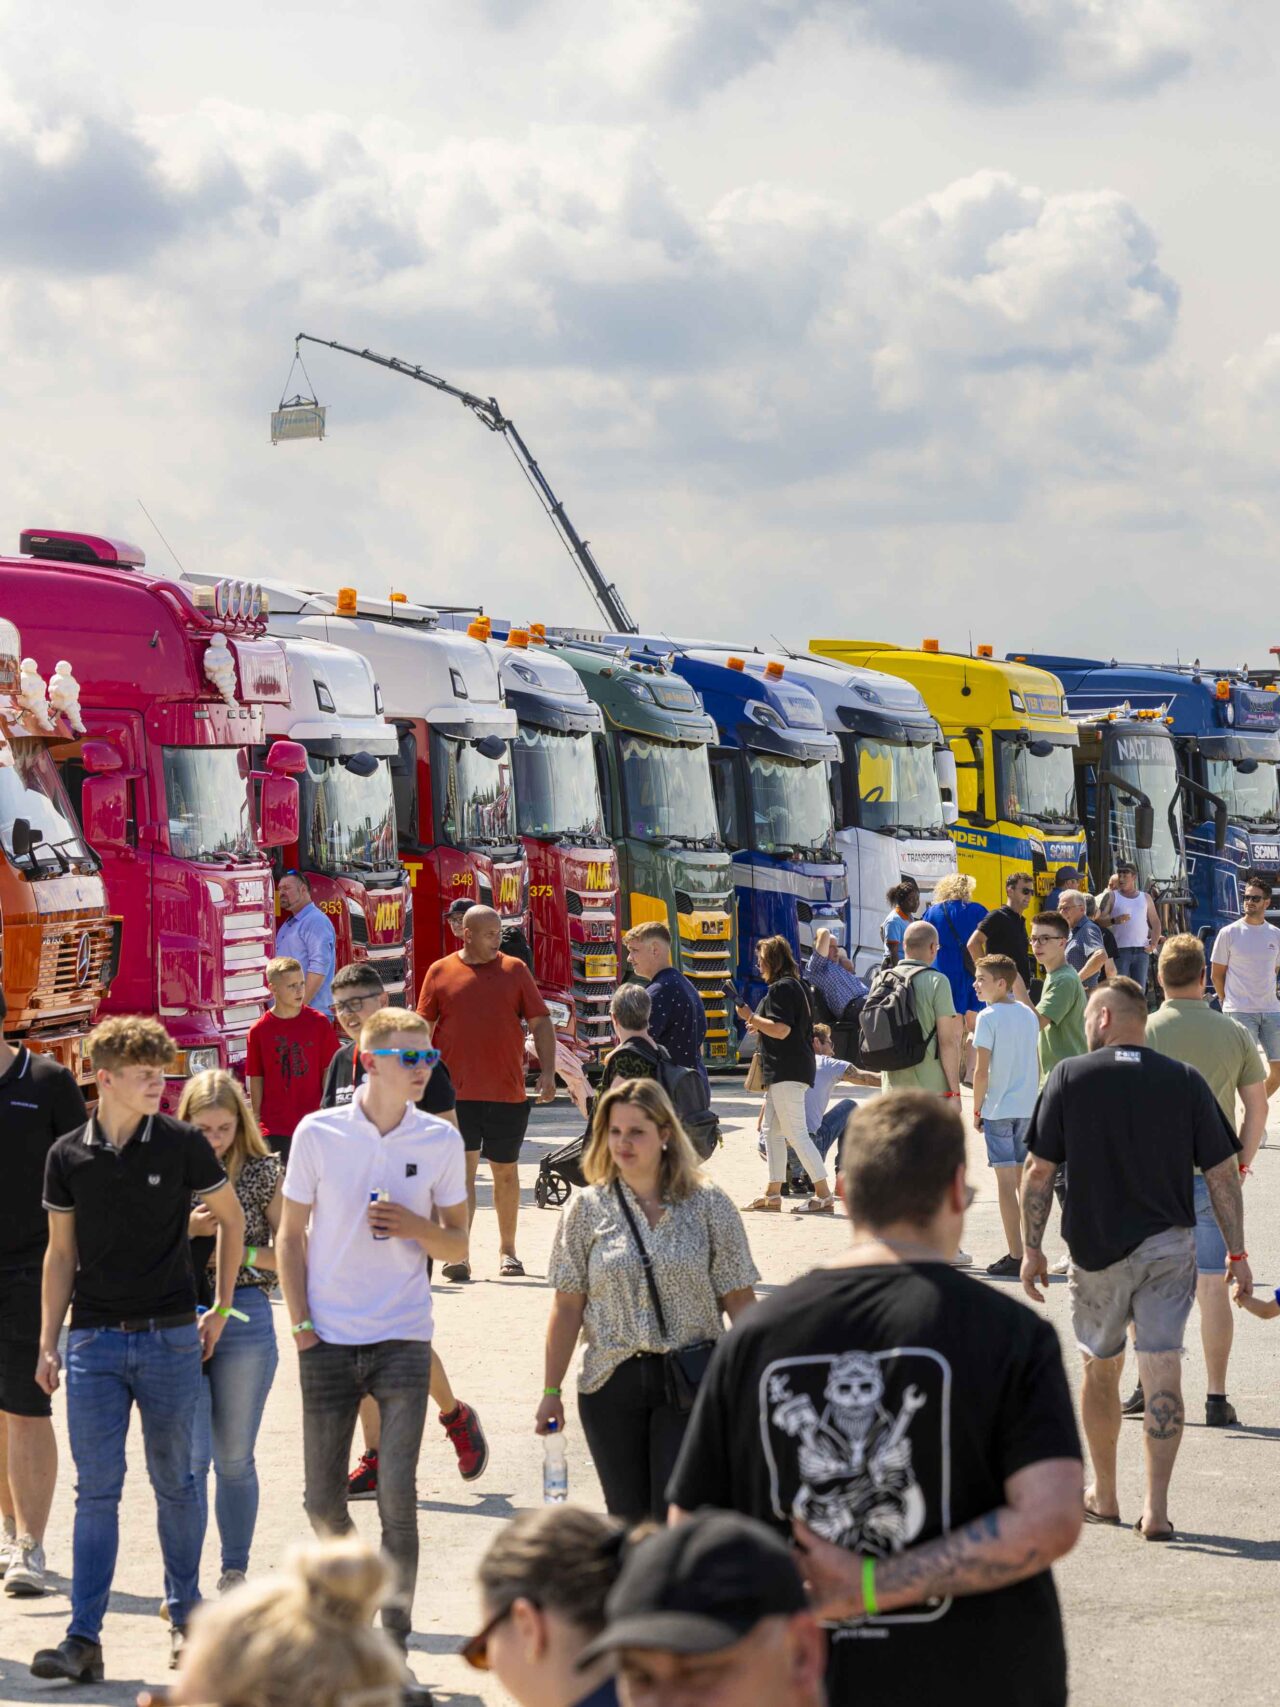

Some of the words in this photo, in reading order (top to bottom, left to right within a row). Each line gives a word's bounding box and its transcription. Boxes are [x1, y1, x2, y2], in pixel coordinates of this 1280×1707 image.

[1116, 739, 1149, 761] NADZ
[947, 829, 988, 847] NDEN
[1050, 844, 1075, 859] SCANIA
[1254, 845, 1279, 860] SCANIA
[452, 874, 473, 886] 348
[586, 862, 611, 890] MAAT
[237, 880, 264, 903] SCANIA
[500, 874, 520, 903] MAAT
[529, 885, 553, 898] 375
[319, 901, 342, 914] 353
[375, 901, 402, 932] MAAT
[591, 923, 611, 938] DAF
[701, 920, 724, 935] DAF
